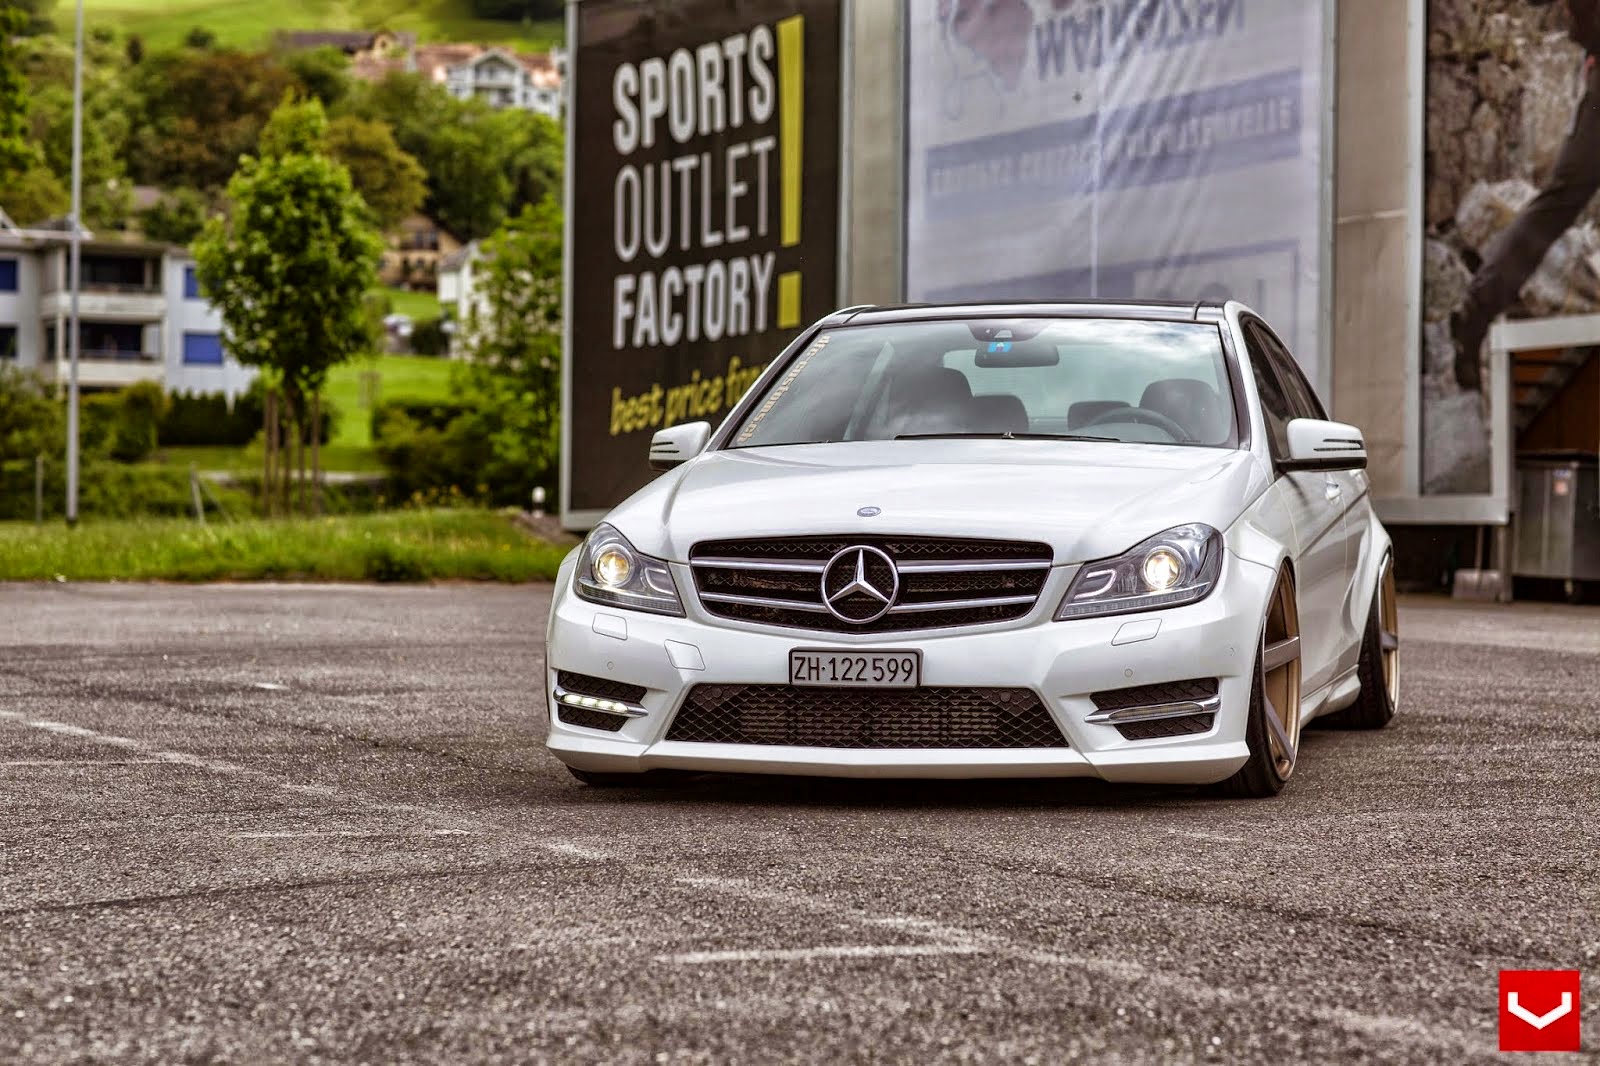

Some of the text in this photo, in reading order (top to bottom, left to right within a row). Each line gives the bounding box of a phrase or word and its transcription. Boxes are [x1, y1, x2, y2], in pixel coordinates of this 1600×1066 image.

[613, 24, 774, 156] SPORTS
[613, 136, 775, 262] OUTLET
[613, 253, 775, 349] FACTORY
[610, 386, 664, 437] best
[664, 369, 724, 429] price
